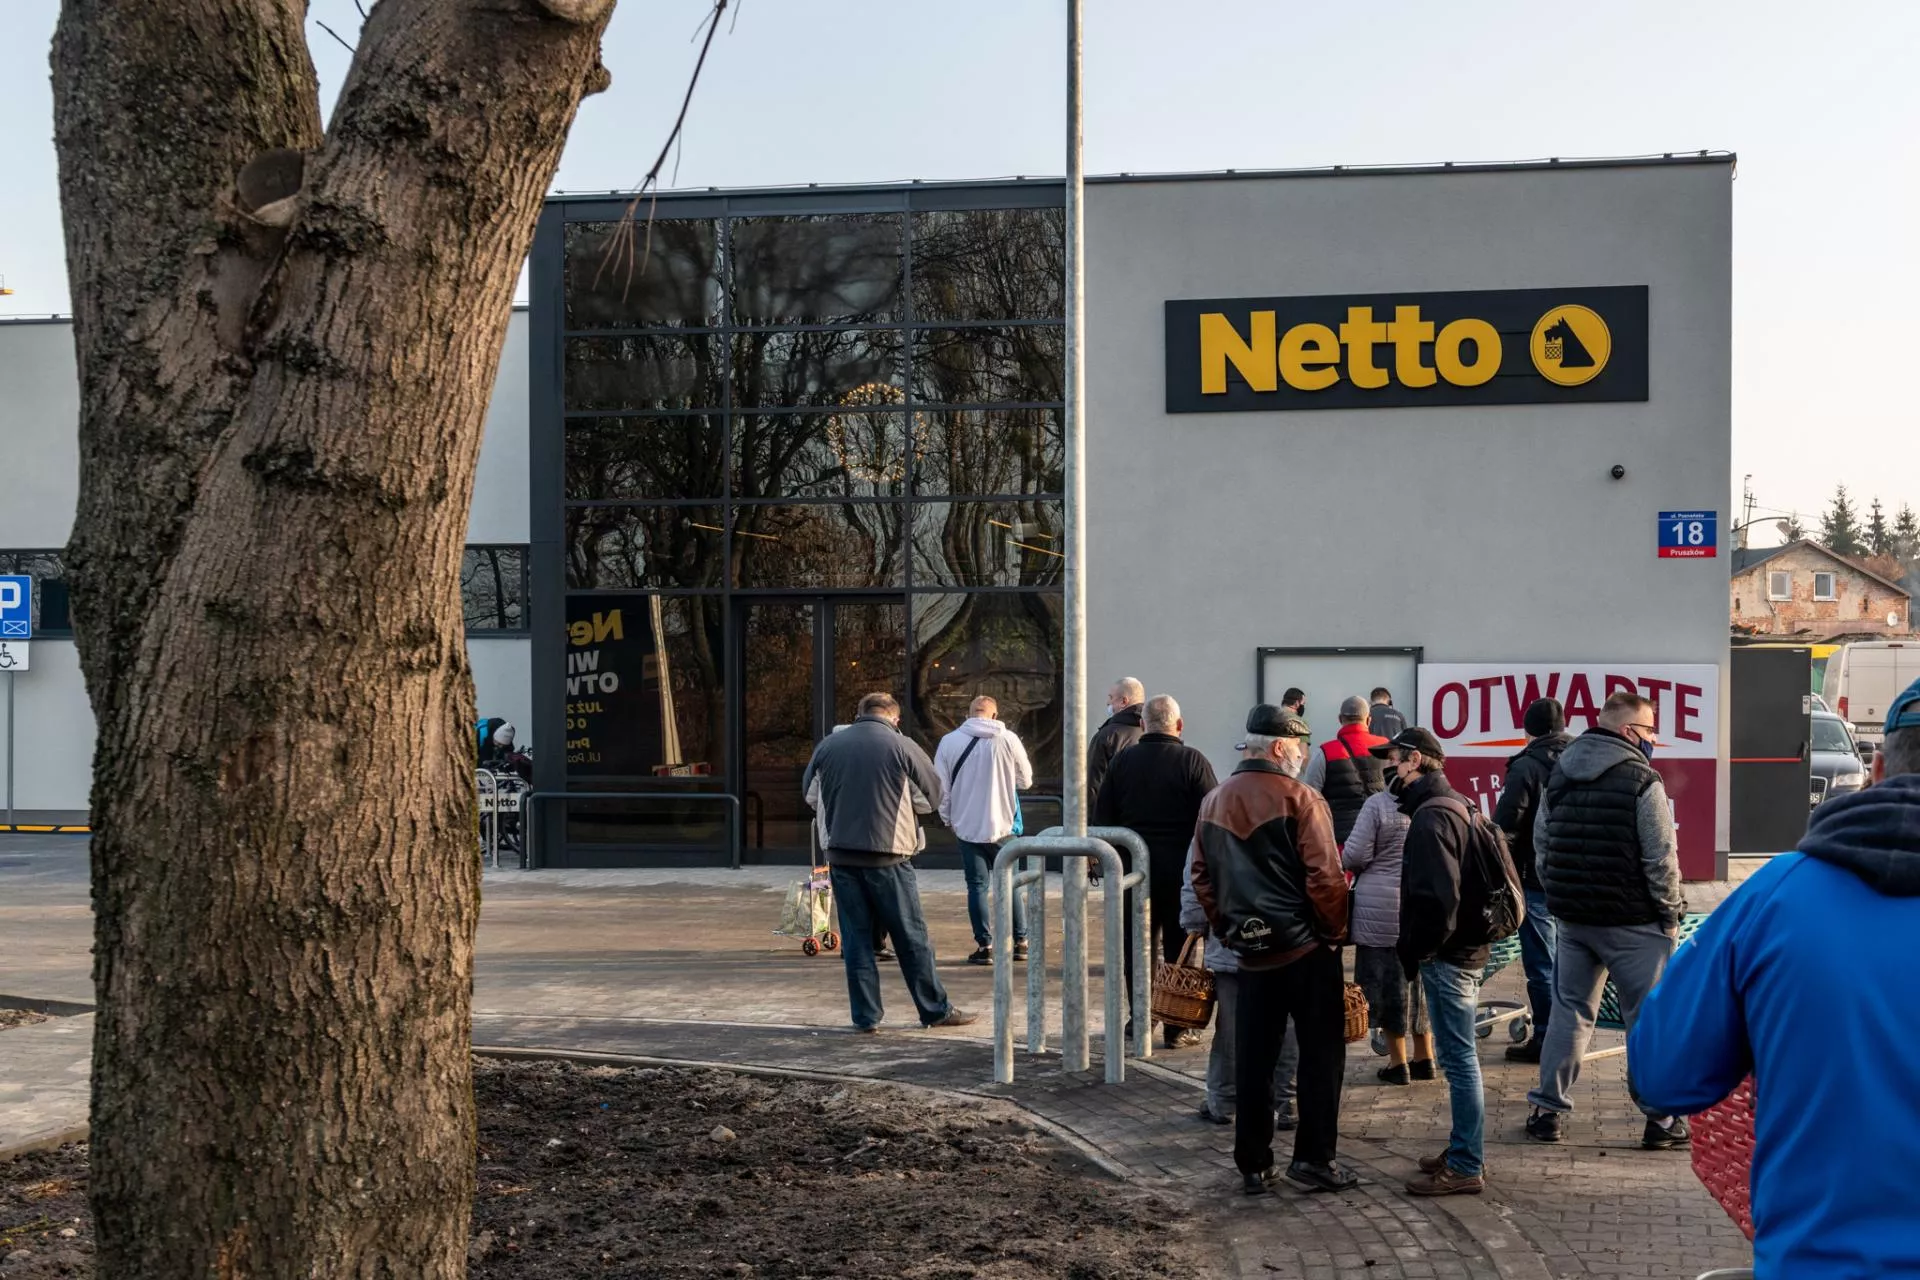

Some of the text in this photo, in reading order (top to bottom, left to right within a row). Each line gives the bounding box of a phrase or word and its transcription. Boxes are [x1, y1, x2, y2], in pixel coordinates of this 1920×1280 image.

[1200, 305, 1503, 394] Netto
[1672, 521, 1704, 545] 18
[0, 581, 21, 619] P
